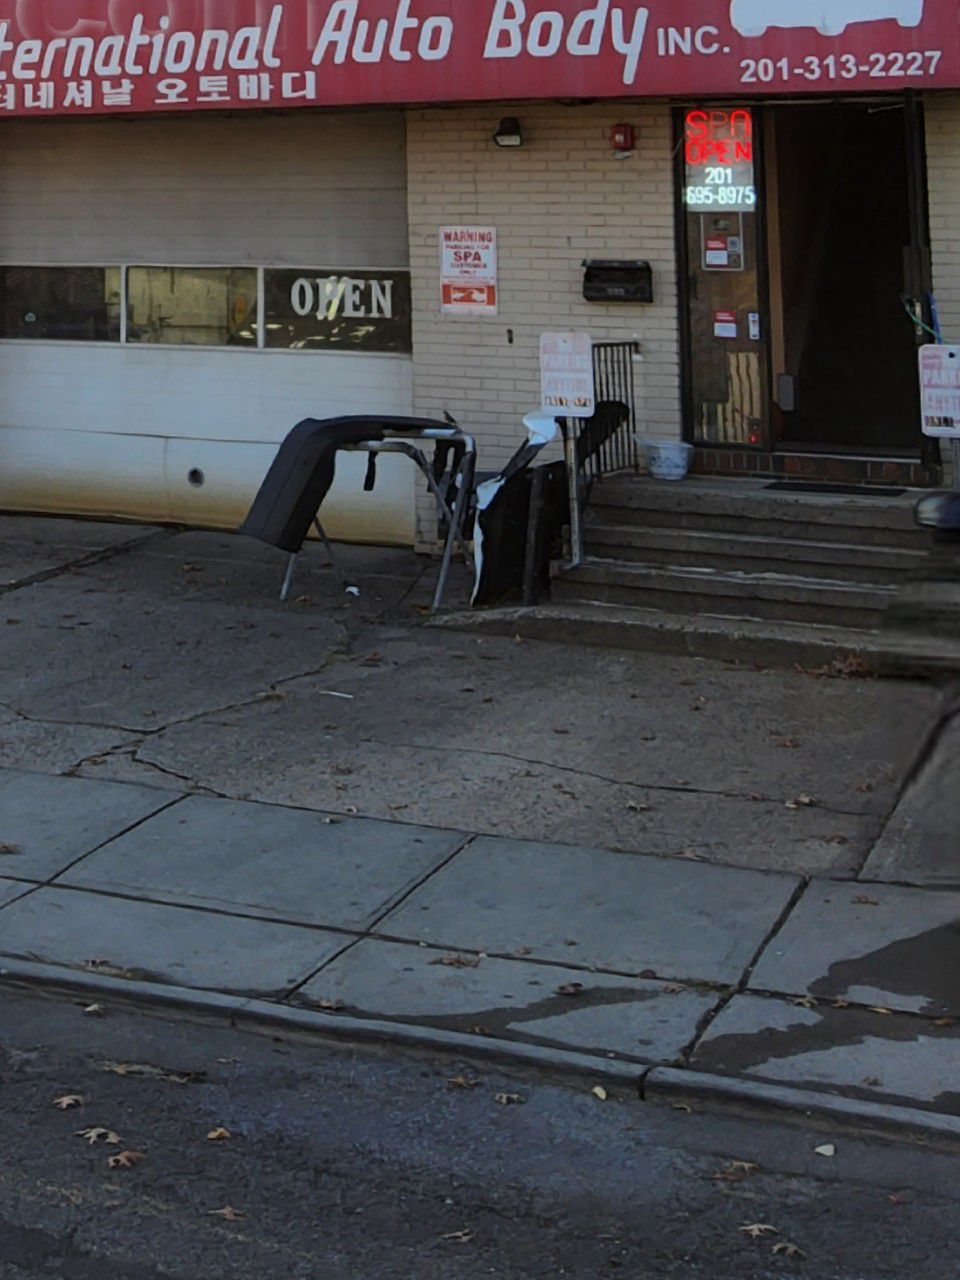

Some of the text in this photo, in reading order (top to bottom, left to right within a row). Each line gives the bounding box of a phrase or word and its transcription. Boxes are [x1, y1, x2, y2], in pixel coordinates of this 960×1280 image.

[657, 25, 731, 56] INC.
[740, 50, 943, 83] 201-313-2227
[154, 70, 317, 103] 오토바디
[686, 110, 751, 138] SPA
[685, 140, 751, 165] OPEN
[704, 167, 732, 184] 201
[443, 231, 492, 242] WARNING
[453, 250, 482, 262] SPA
[291, 276, 393, 320] OPEN
